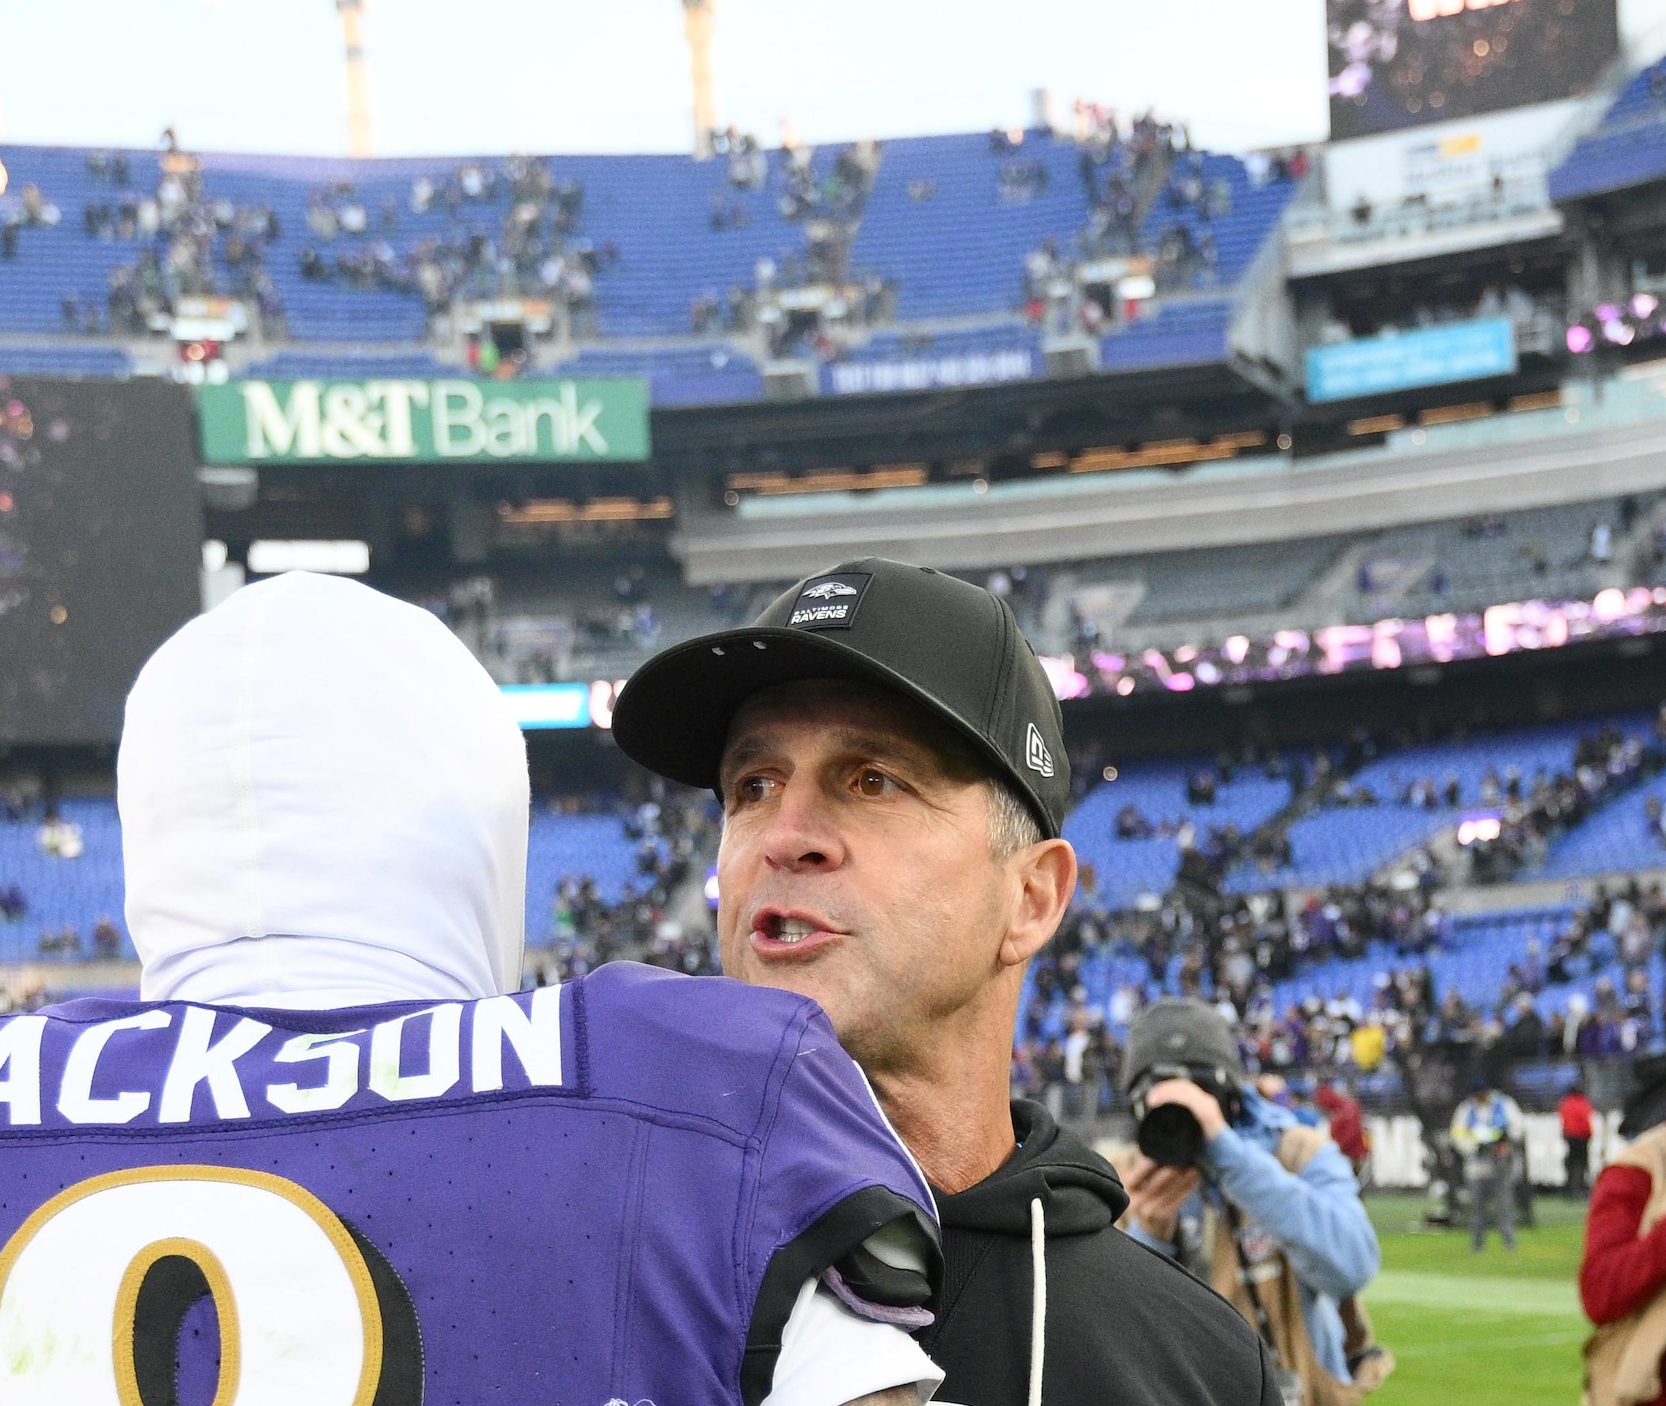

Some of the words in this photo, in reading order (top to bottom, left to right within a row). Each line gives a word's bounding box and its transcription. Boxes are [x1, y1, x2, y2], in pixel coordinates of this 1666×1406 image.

[240, 379, 430, 459] M&T
[434, 379, 610, 459] Bank
[790, 609, 847, 625] RAVENS
[794, 604, 849, 616] BALTIMORE
